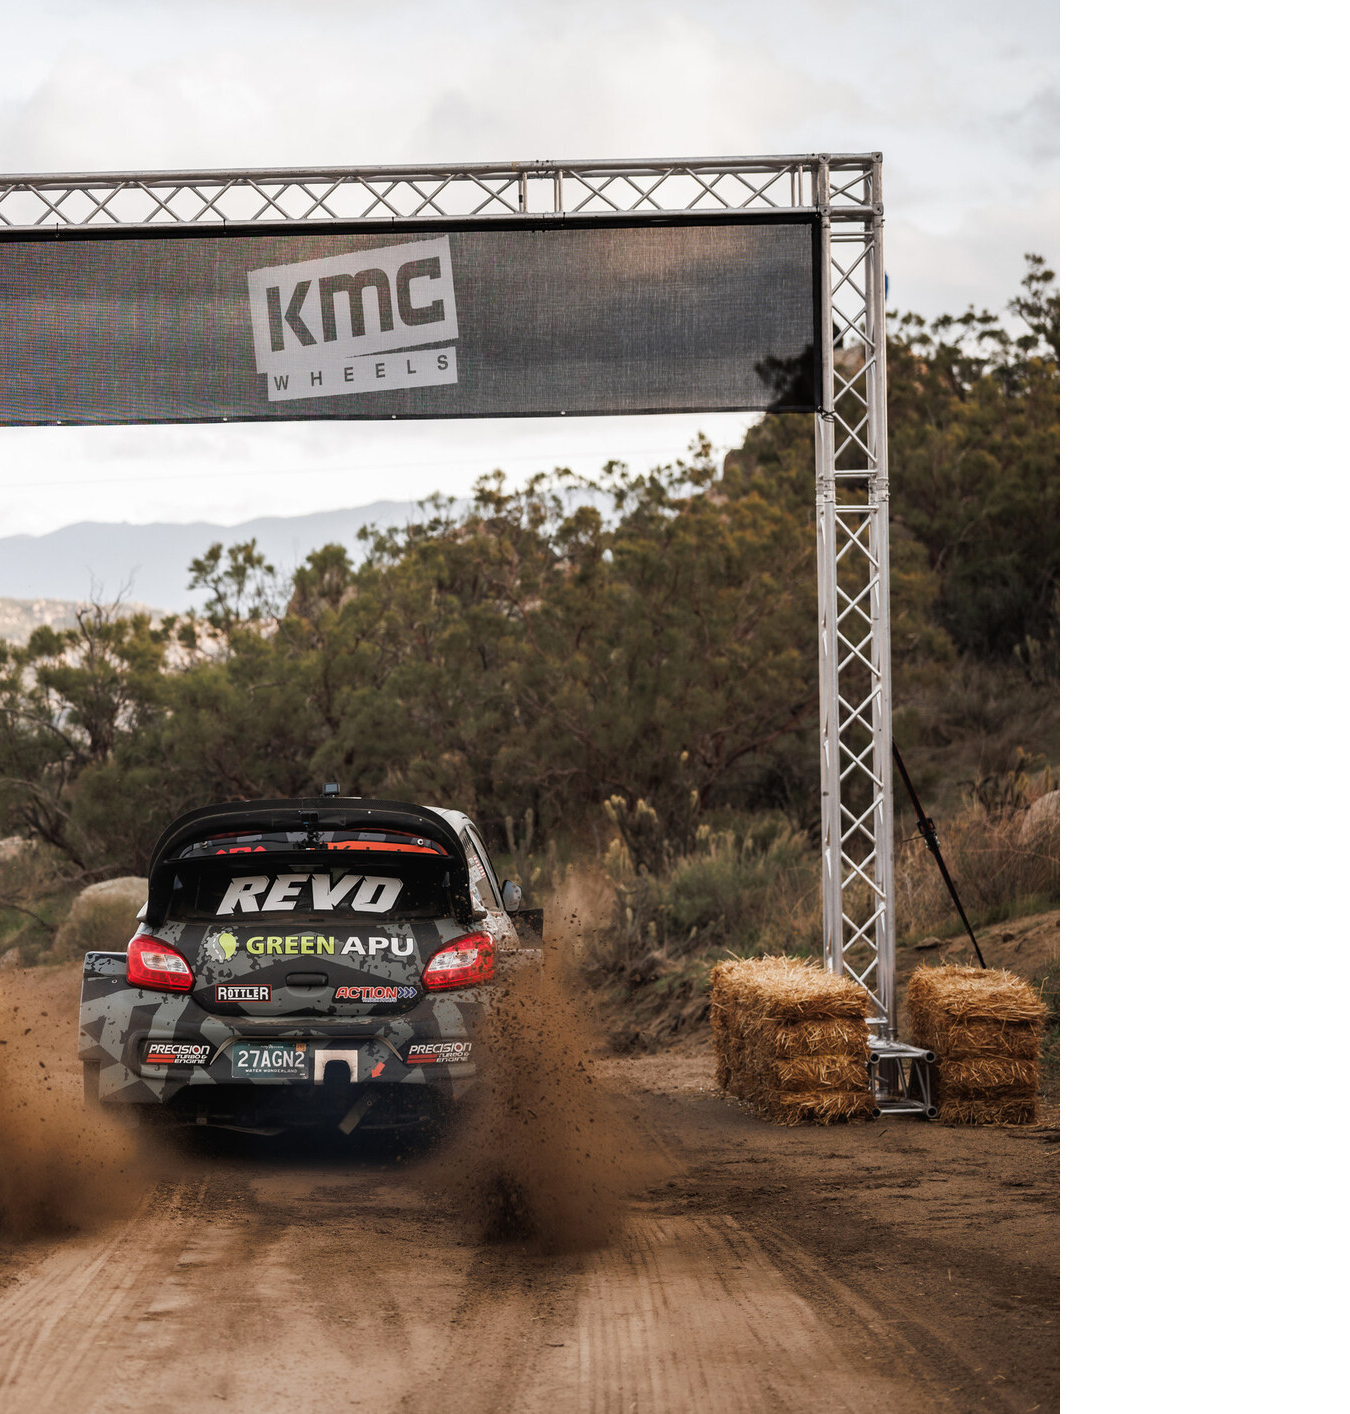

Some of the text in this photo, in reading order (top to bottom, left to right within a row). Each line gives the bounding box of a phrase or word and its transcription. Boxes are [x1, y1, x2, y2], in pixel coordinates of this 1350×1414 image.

[274, 354, 449, 391] WHEELS
[216, 873, 403, 916] REVO
[246, 936, 414, 956] GREEN APU
[218, 986, 269, 1000] ROTTLER
[335, 986, 398, 999] ACTION
[148, 1044, 210, 1055] PRECISION
[408, 1042, 472, 1055] PRECISION
[237, 1050, 305, 1068] 27AGN2
